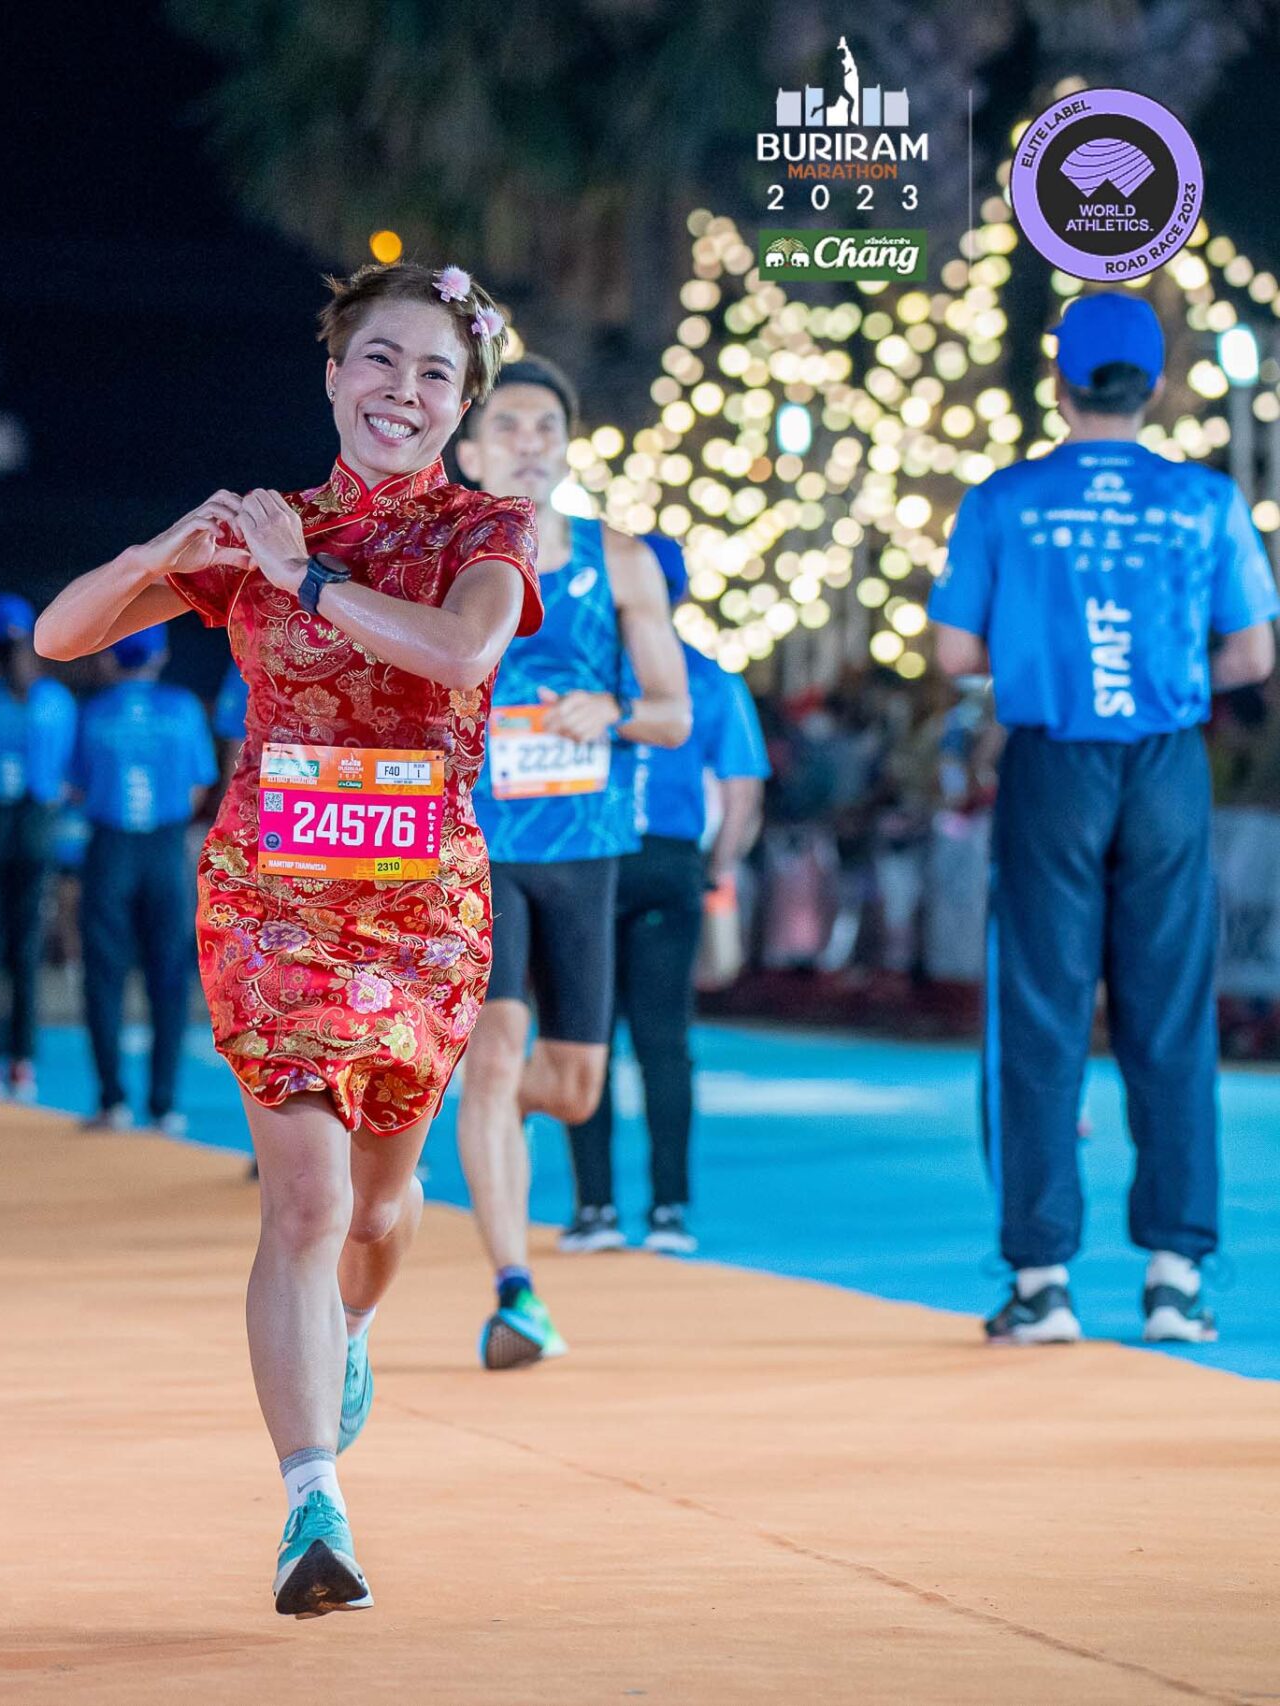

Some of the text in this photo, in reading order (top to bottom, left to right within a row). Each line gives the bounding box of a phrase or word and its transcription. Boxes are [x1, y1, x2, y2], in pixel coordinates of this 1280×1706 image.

[1086, 597, 1136, 717] STAFF
[384, 766, 400, 776] F40
[293, 801, 416, 847] 24576
[377, 862, 400, 872] 2310
